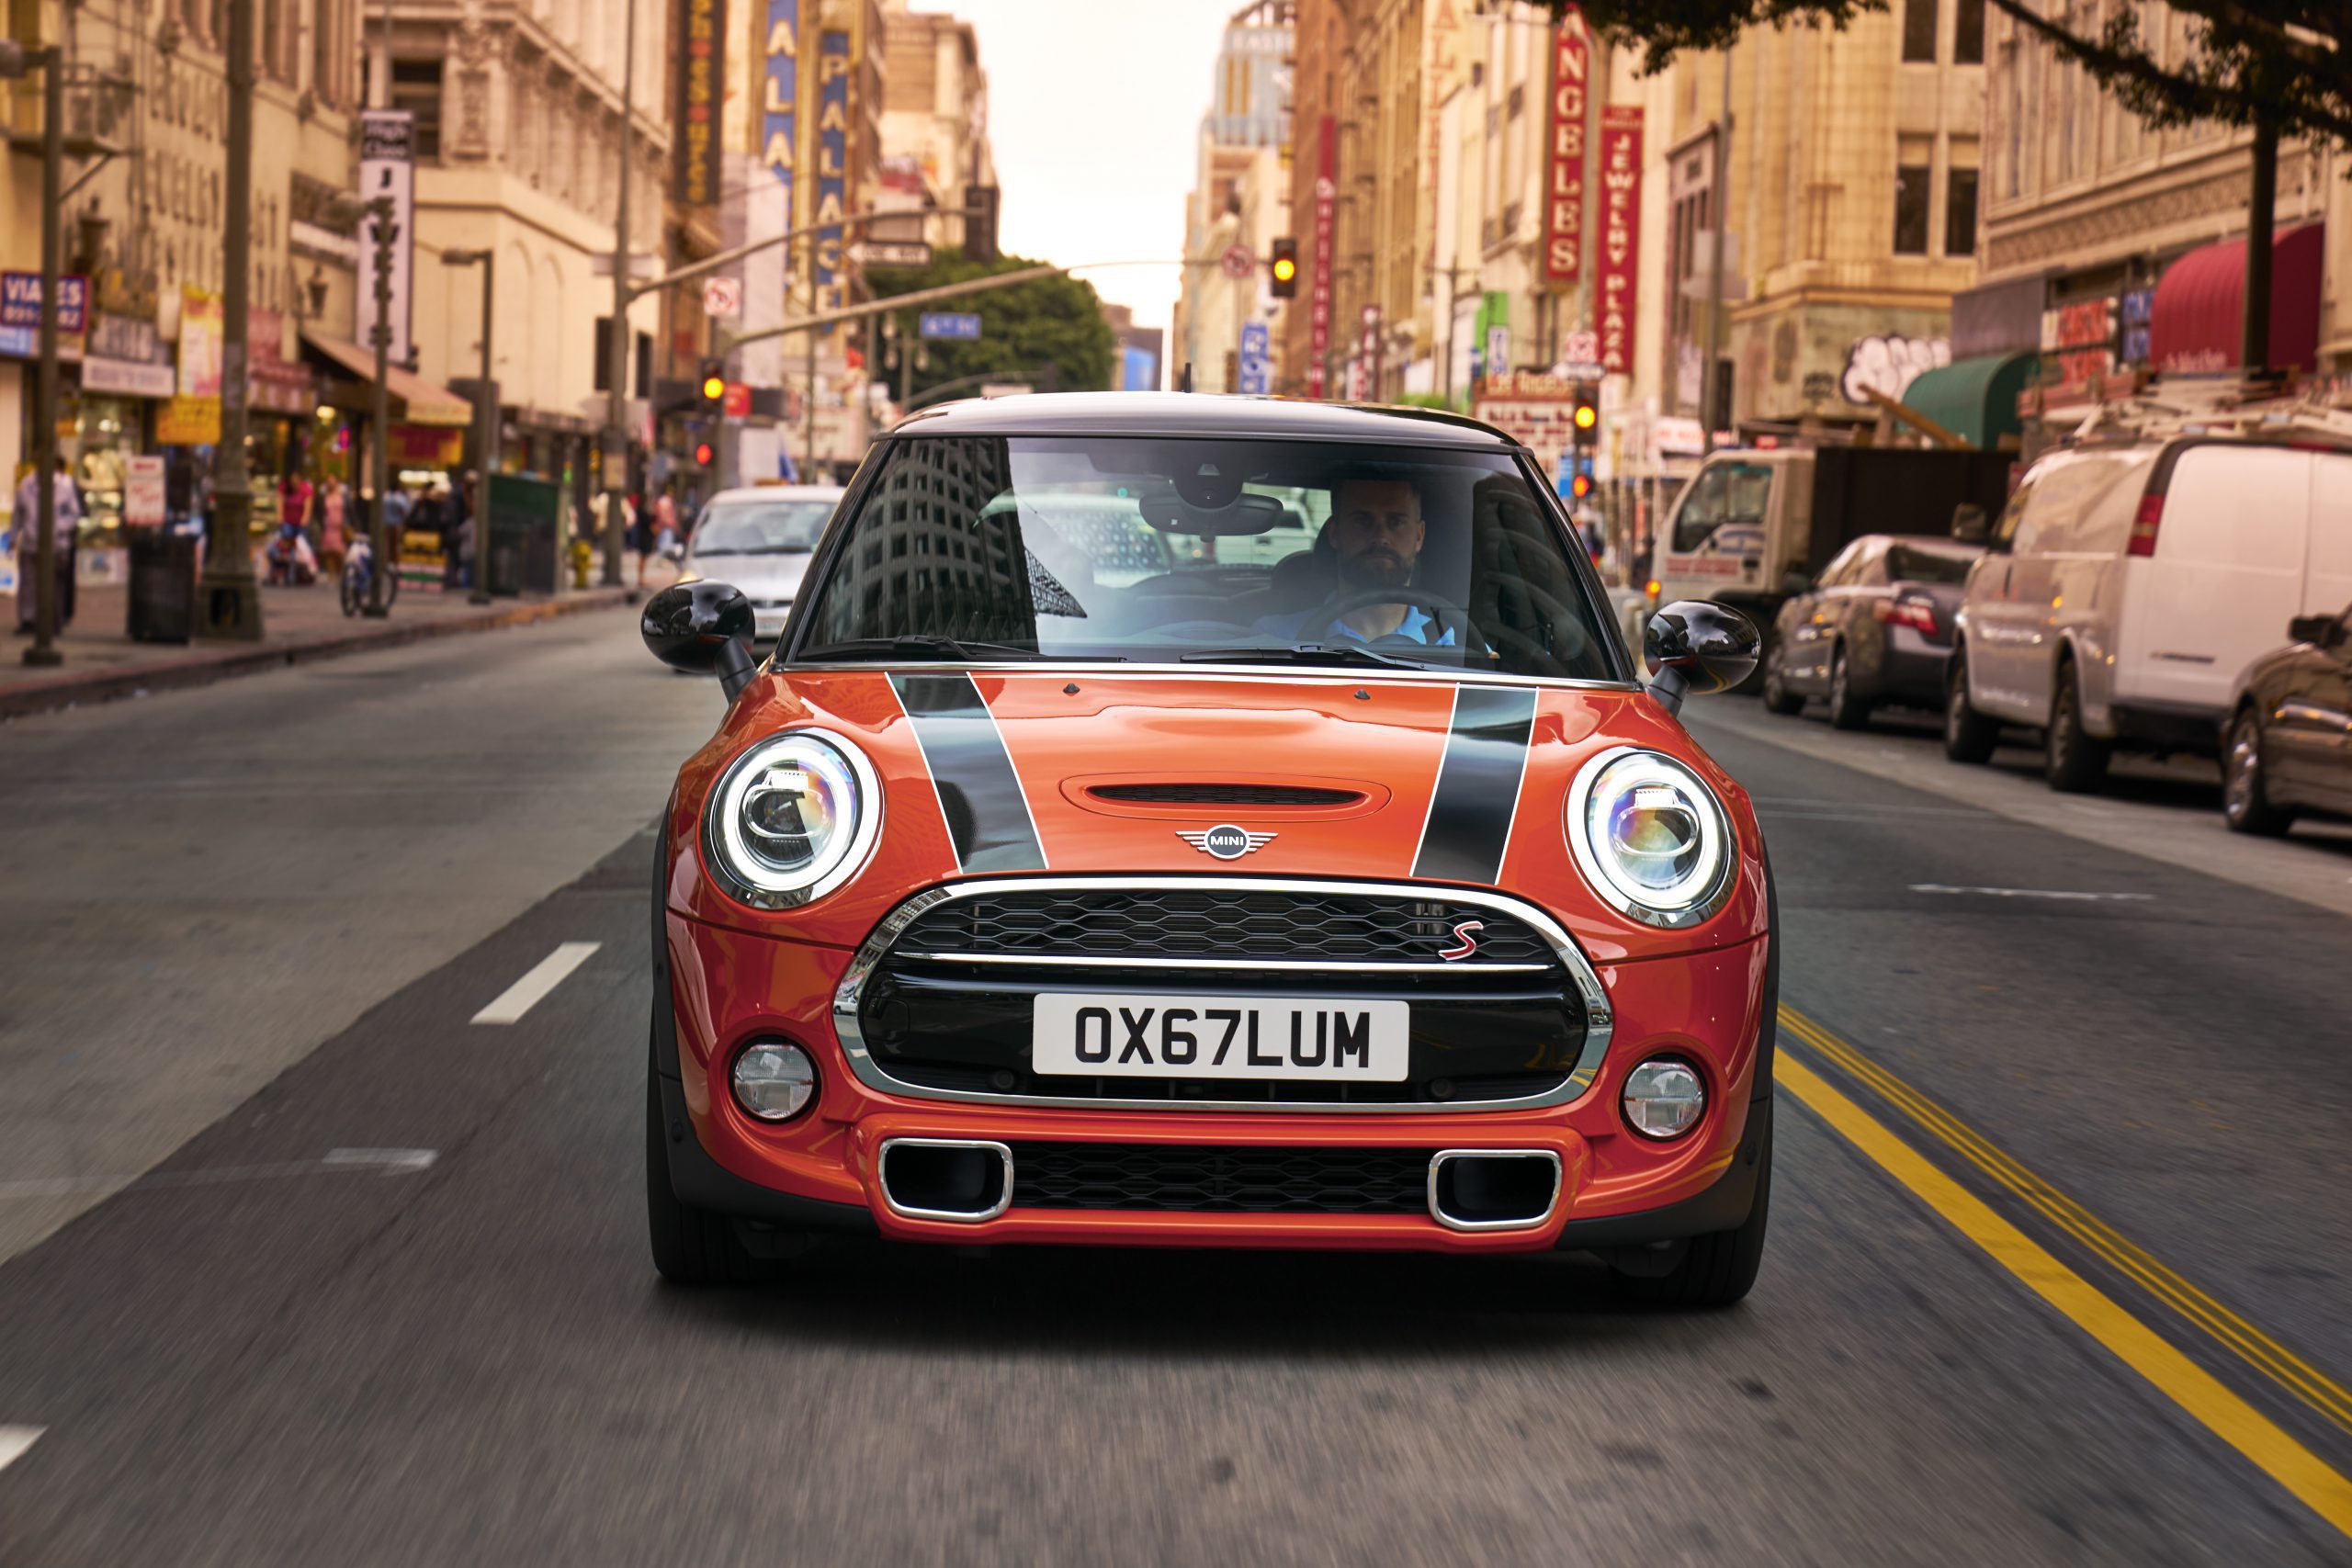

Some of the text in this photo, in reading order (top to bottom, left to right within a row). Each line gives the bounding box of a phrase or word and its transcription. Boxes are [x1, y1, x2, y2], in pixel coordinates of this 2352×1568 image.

[1549, 8, 1587, 272] ANGELES
[815, 53, 849, 313] PALACE
[1602, 134, 1636, 367] JEWELRY PLAZA
[6, 277, 81, 306] VIAES
[1210, 836, 1244, 845] MINI
[1438, 920, 1484, 961] S
[1075, 1007, 1370, 1068] OX67LUM
